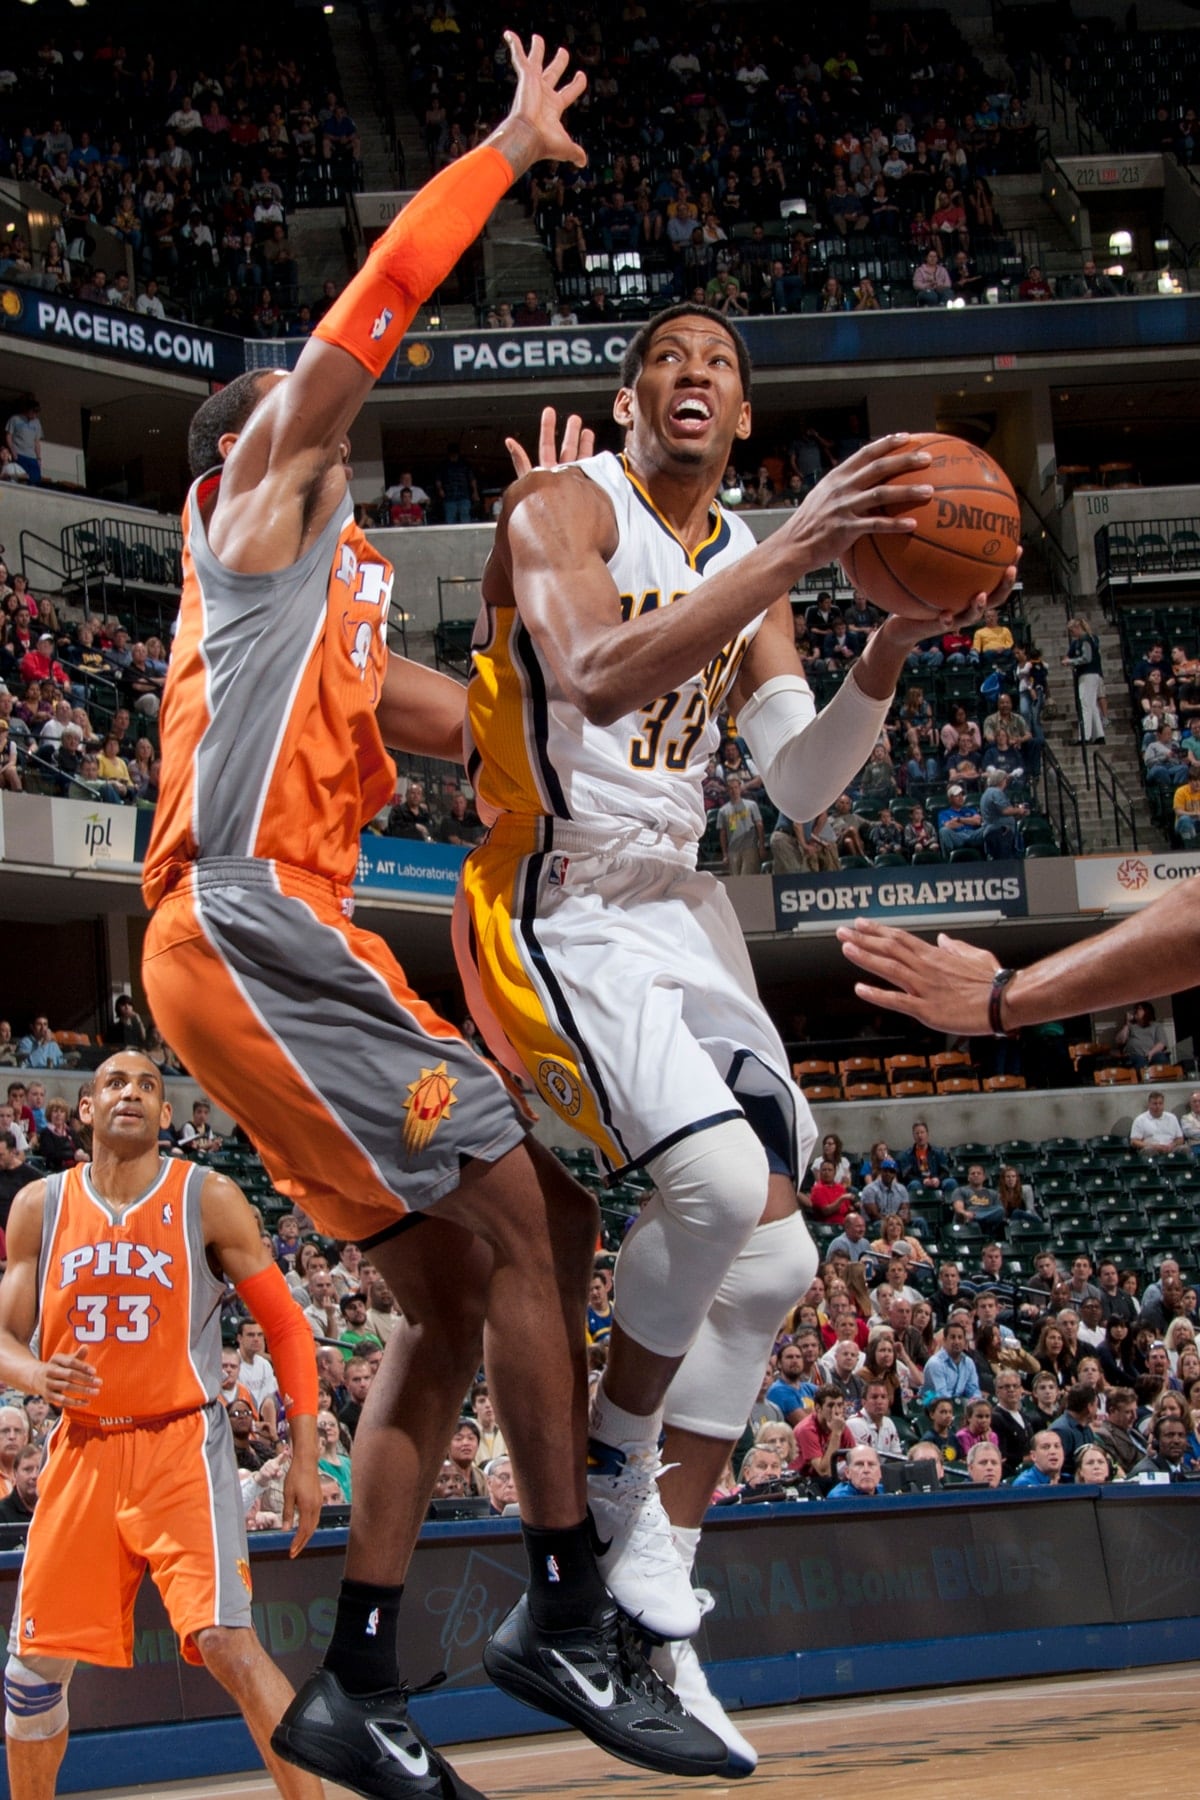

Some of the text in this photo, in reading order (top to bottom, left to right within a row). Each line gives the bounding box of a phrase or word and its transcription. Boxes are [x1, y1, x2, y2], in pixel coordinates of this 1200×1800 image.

[1077, 169, 1094, 185] 212
[1122, 167, 1140, 183] 213
[38, 302, 214, 368] PACERS.COM
[453, 336, 627, 371] PACERS.C
[1087, 496, 1109, 514] 108
[630, 690, 706, 773] 33
[85, 816, 112, 857] ipl
[376, 861, 460, 882] AIT Laboratories
[1153, 864, 1200, 880] Com
[780, 877, 1020, 913] SPORT GRAPHICS
[60, 1241, 174, 1290] PHX
[74, 1295, 151, 1343] 33
